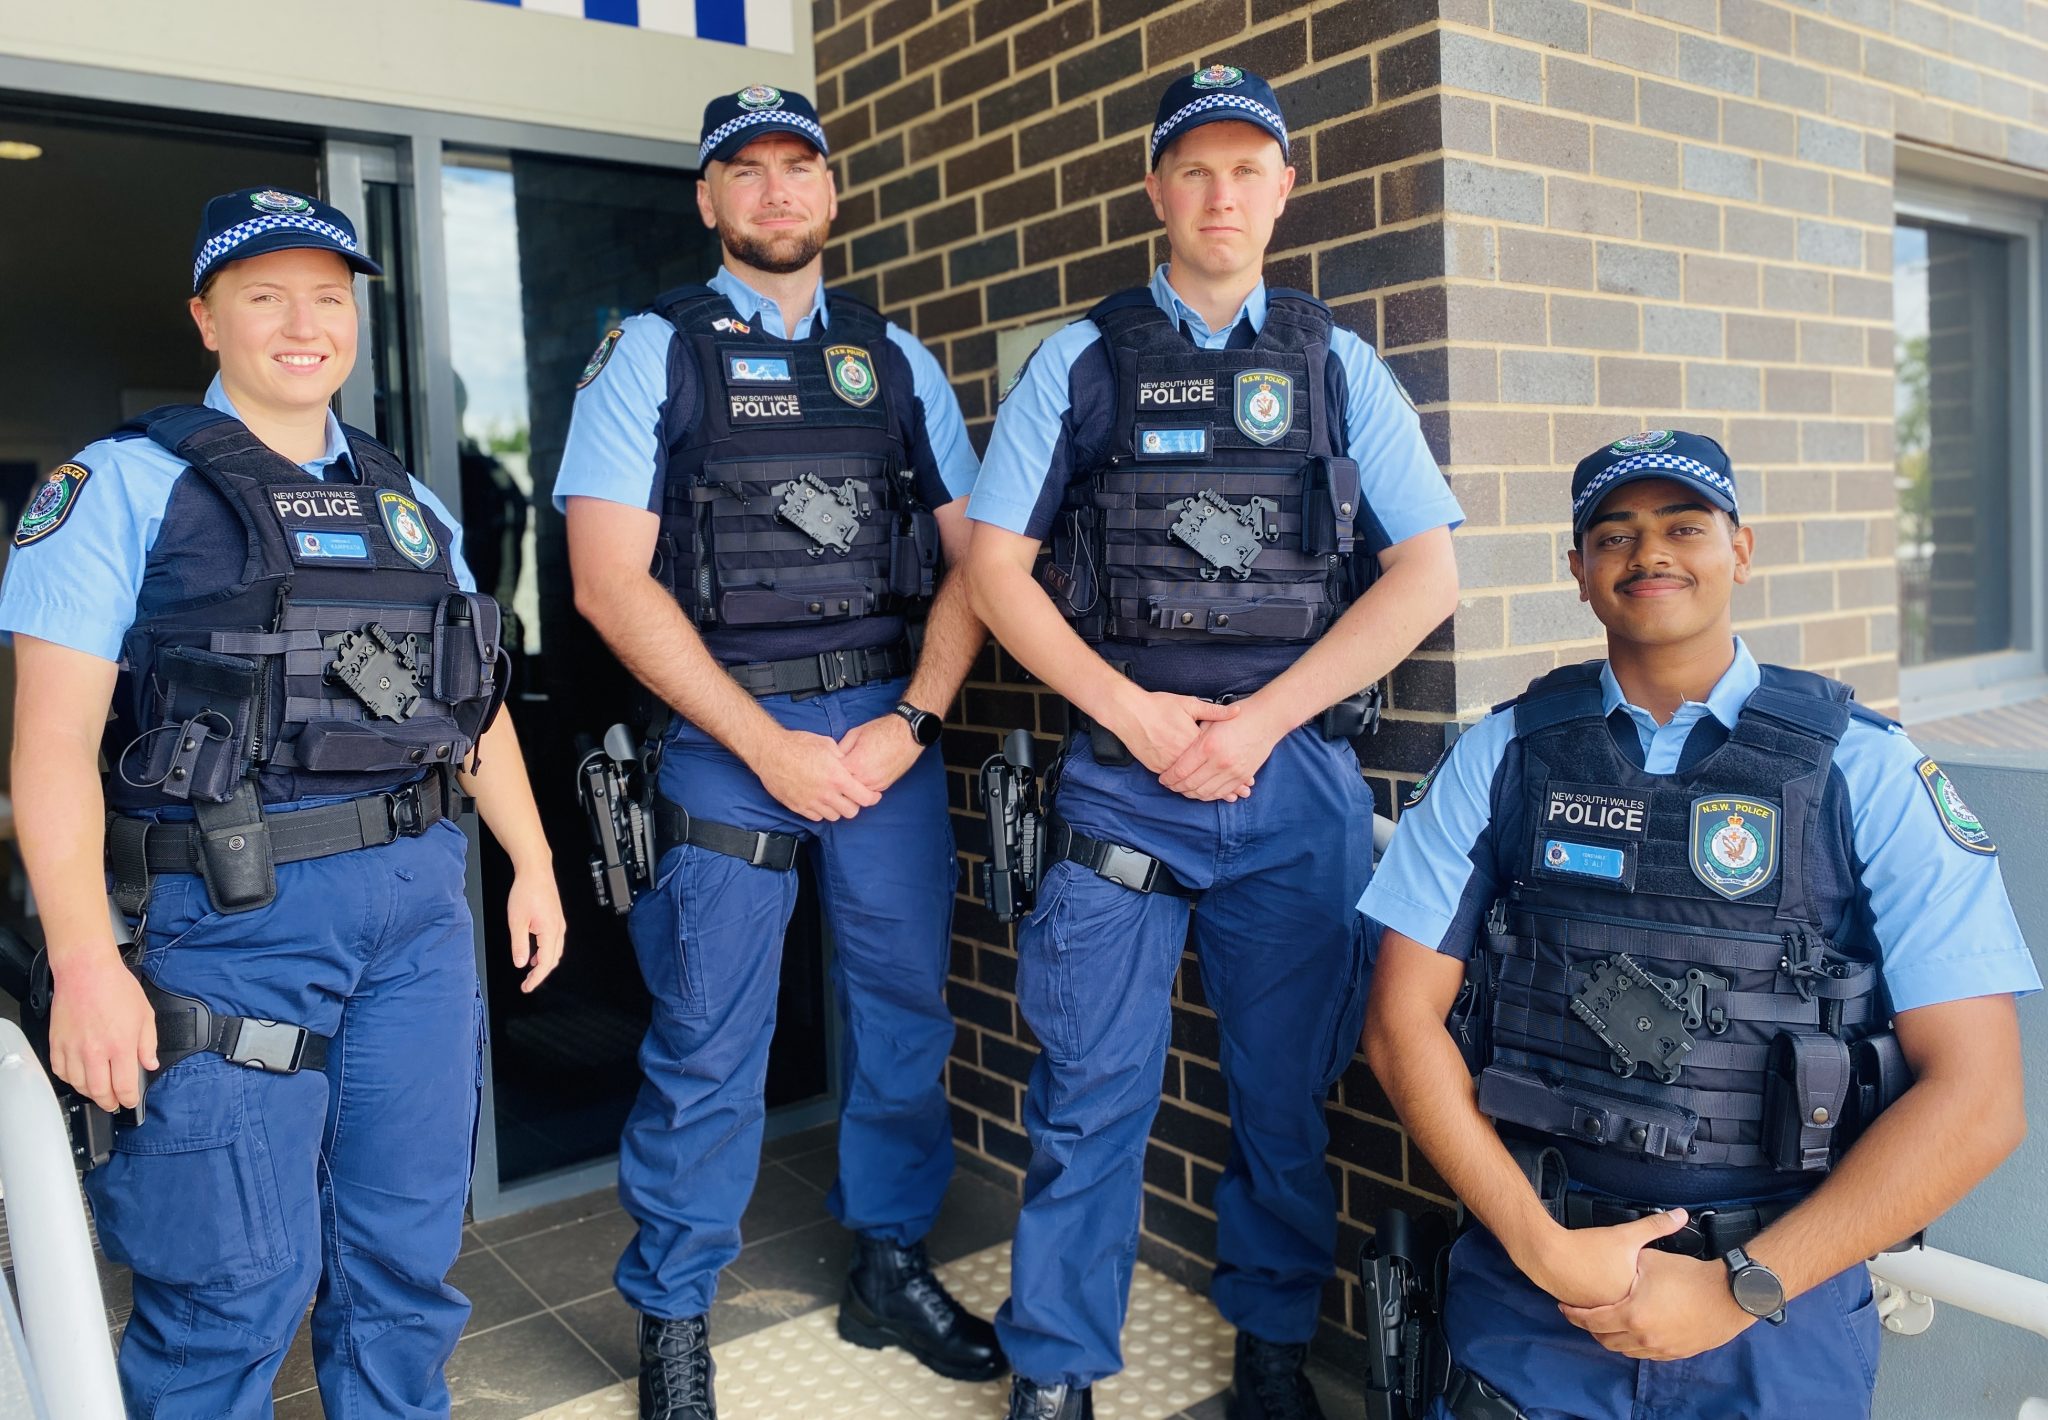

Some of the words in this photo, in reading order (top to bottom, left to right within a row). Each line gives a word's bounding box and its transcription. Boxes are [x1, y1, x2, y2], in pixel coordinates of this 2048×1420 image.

[1160, 380, 1186, 388] SOUTH
[1187, 378, 1215, 386] WALES
[1264, 375, 1287, 386] POLICE
[1140, 385, 1215, 405] POLICE
[731, 401, 801, 417] POLICE
[273, 492, 294, 500] NEW
[295, 491, 326, 499] SOUTH
[327, 491, 356, 499] WALES
[276, 498, 363, 518] POLICE
[1551, 791, 1575, 802] NEW
[1575, 794, 1608, 805] SOUTH
[1609, 797, 1645, 810] WALES
[1548, 800, 1644, 832] POLICE
[1702, 803, 1731, 814] N.S.W.
[1735, 803, 1770, 819] POLICE
